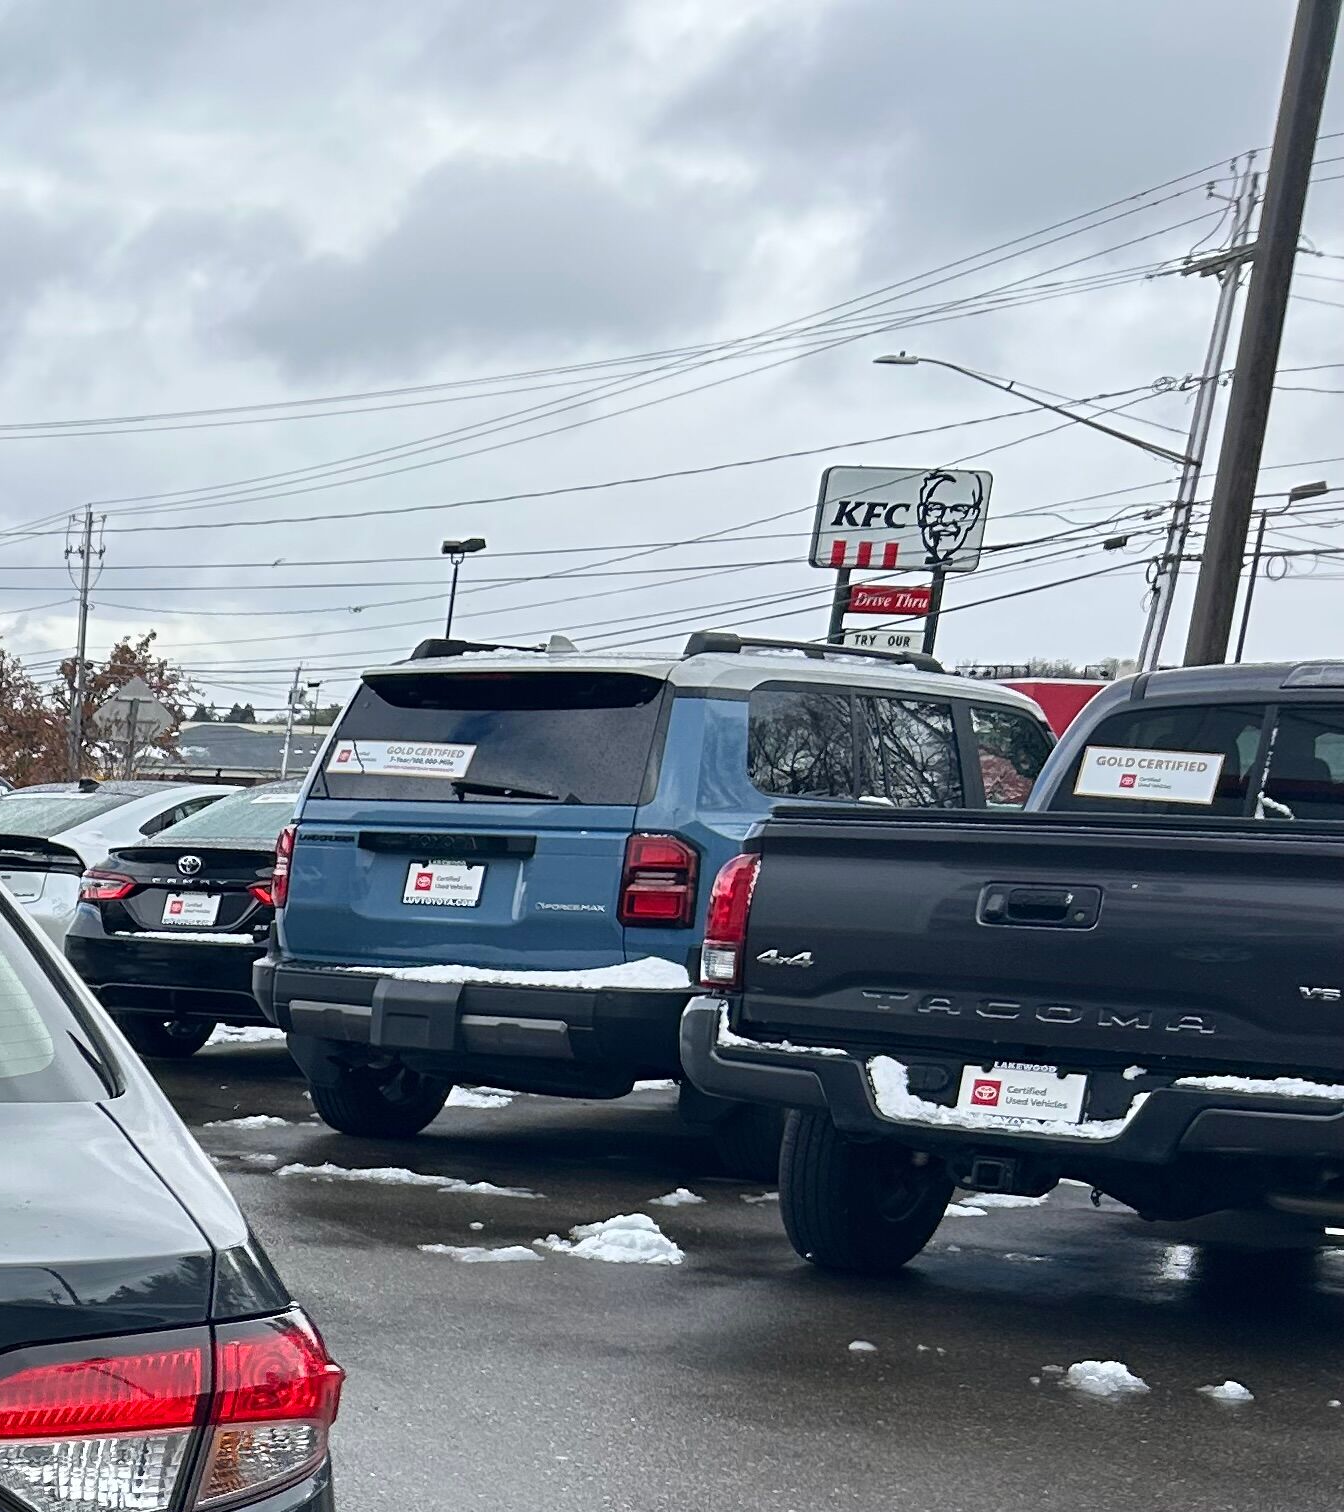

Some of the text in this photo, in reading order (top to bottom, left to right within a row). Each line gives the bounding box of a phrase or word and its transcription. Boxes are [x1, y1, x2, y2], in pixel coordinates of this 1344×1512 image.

[830, 500, 912, 529] KFC
[854, 591, 928, 609] Drive Thru
[854, 634, 911, 647] TRY OUR
[386, 745, 465, 759] GOLD CERTIFIED
[1096, 756, 1207, 772] GOLD CERTIFIED
[756, 948, 814, 968] 4x4
[1299, 985, 1341, 1001] V6
[861, 988, 1215, 1035] TACOMA
[993, 1060, 1057, 1074] LAKEWOOD
[1006, 1085, 1047, 1097] Certified
[1005, 1096, 1068, 1110] Used Vehicles
